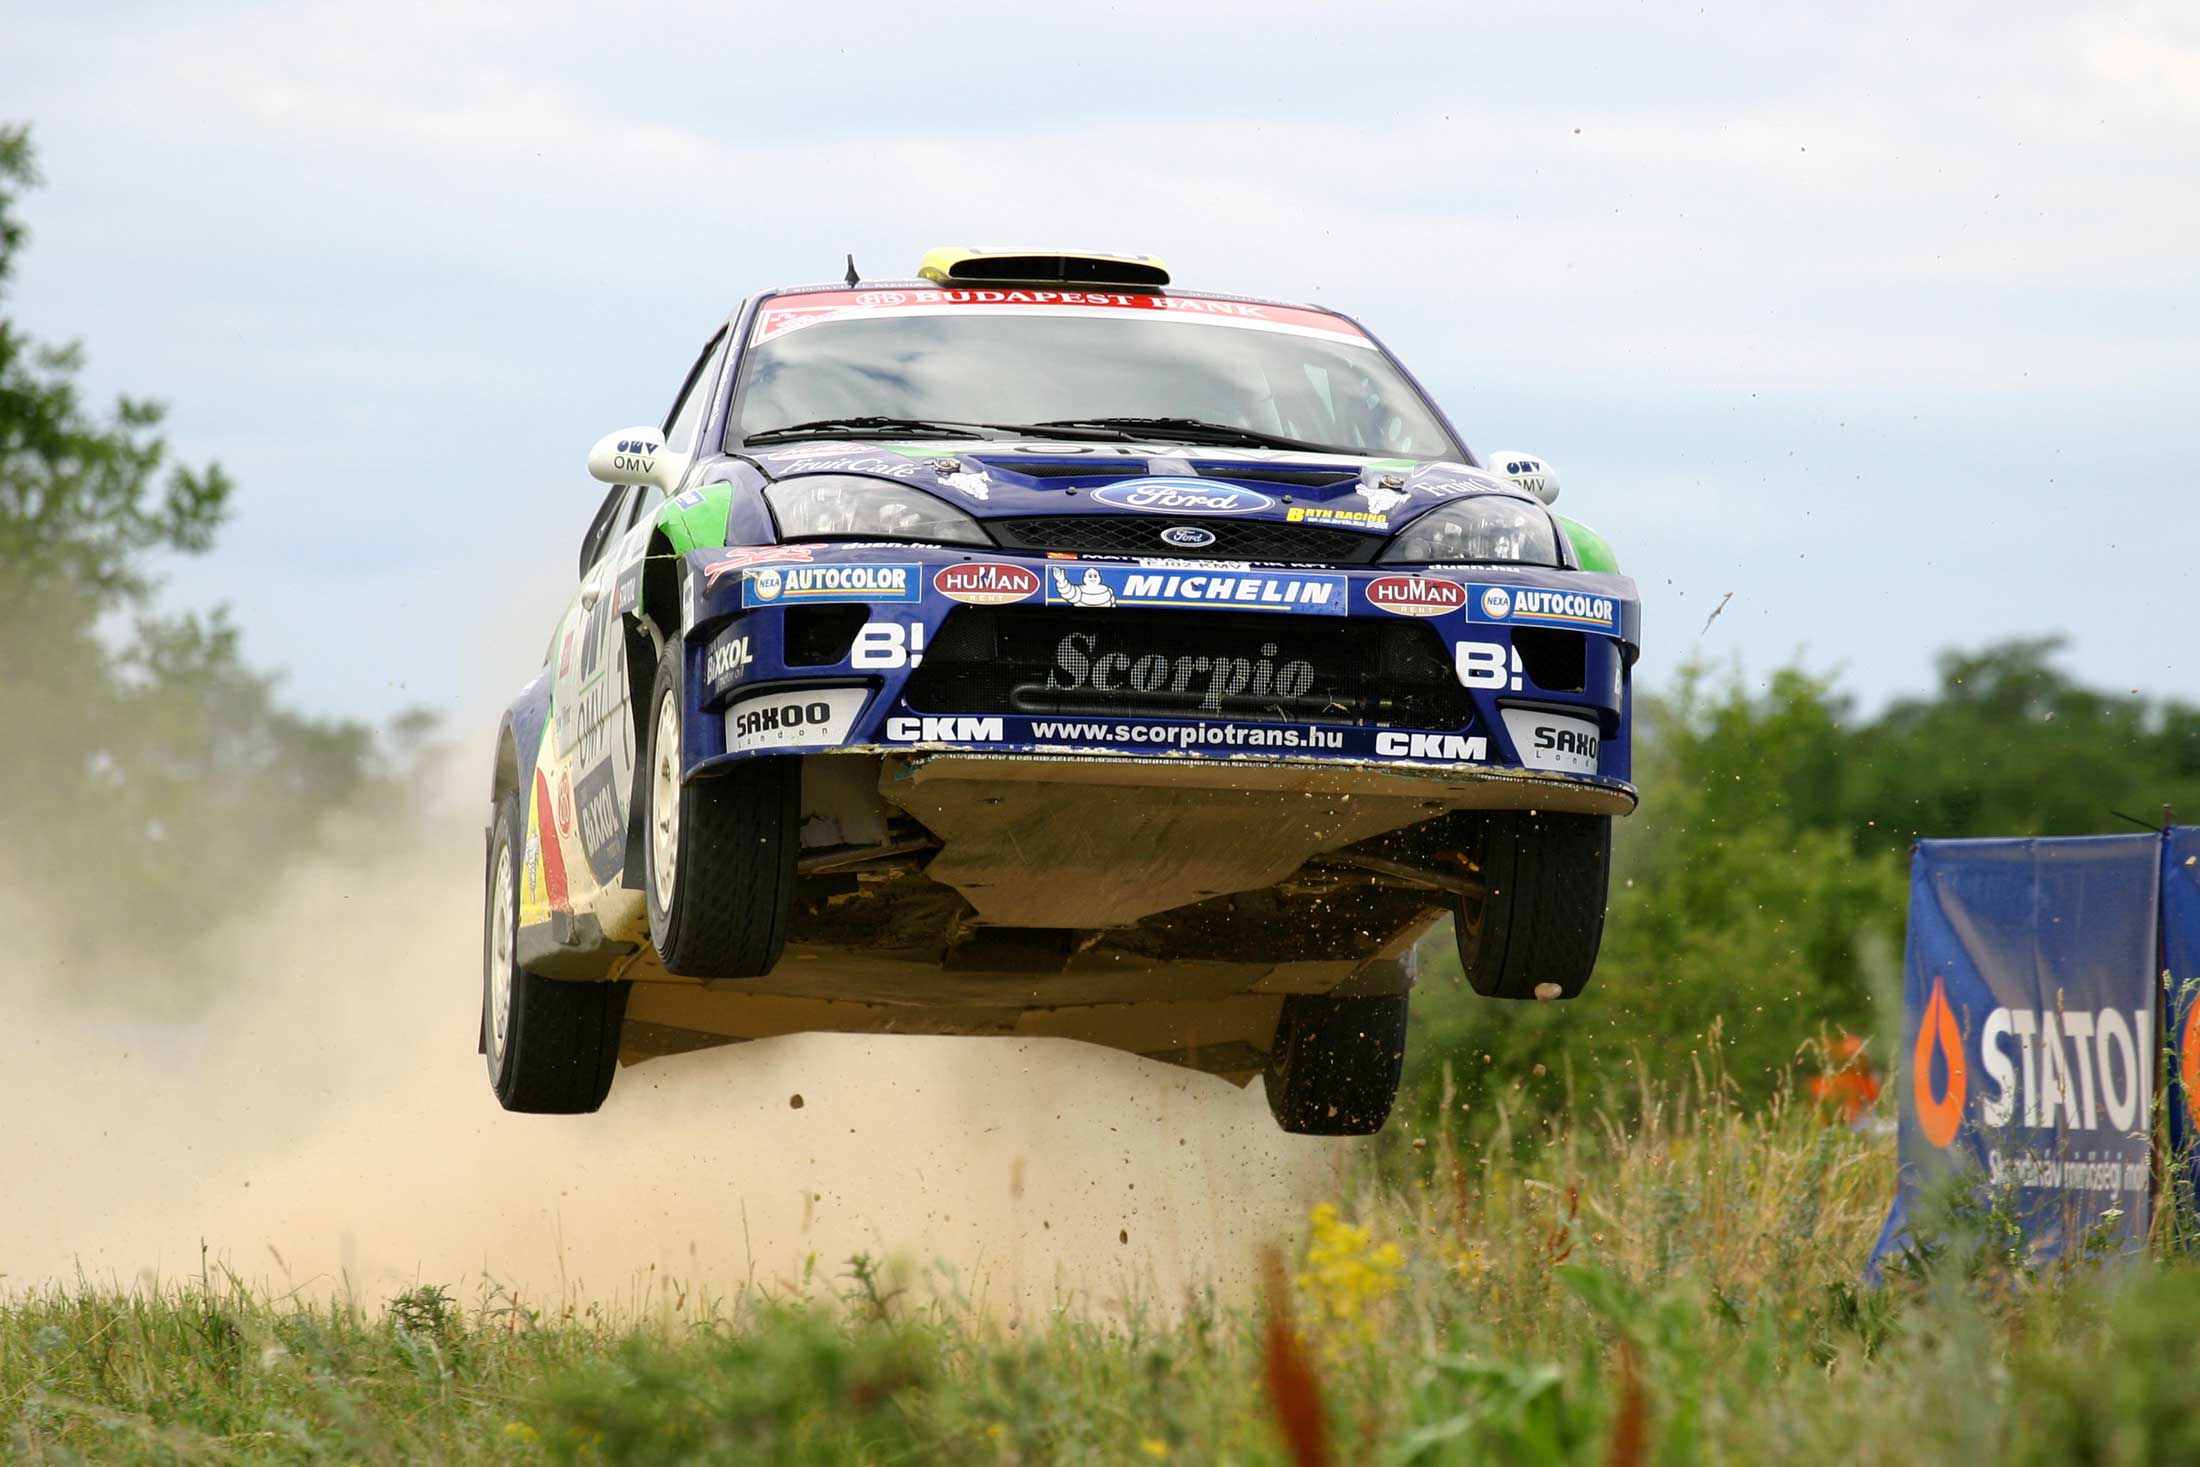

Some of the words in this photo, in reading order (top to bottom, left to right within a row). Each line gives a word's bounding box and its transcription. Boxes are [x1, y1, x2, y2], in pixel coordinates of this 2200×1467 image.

[908, 290, 1136, 306] BUDAPEST
[1151, 297, 1268, 318] BANK
[614, 455, 655, 473] OMV
[1126, 486, 1239, 510] Ford
[1334, 510, 1388, 524] RACING
[1173, 529, 1204, 543] Ford
[759, 576, 780, 589] NEXA
[785, 567, 906, 590] AUTOCOLOR
[1122, 574, 1334, 605] MICHELIN
[969, 594, 1004, 602] RENT
[1400, 605, 1434, 614] RENT
[1487, 596, 1509, 608] NEXA
[1514, 590, 1613, 621] AUTOCOLOR
[850, 622, 924, 669] B!
[706, 636, 753, 686] BiXXOL
[1045, 632, 1315, 710] Scorpio
[1455, 640, 1523, 692] B!
[736, 702, 831, 739] SAXOO
[738, 726, 828, 749] London
[886, 717, 1004, 742] CKM
[1030, 721, 1344, 748] www.scorpiotrans.hu
[1375, 731, 1488, 761] CKM
[1534, 726, 1600, 759] SAXO
